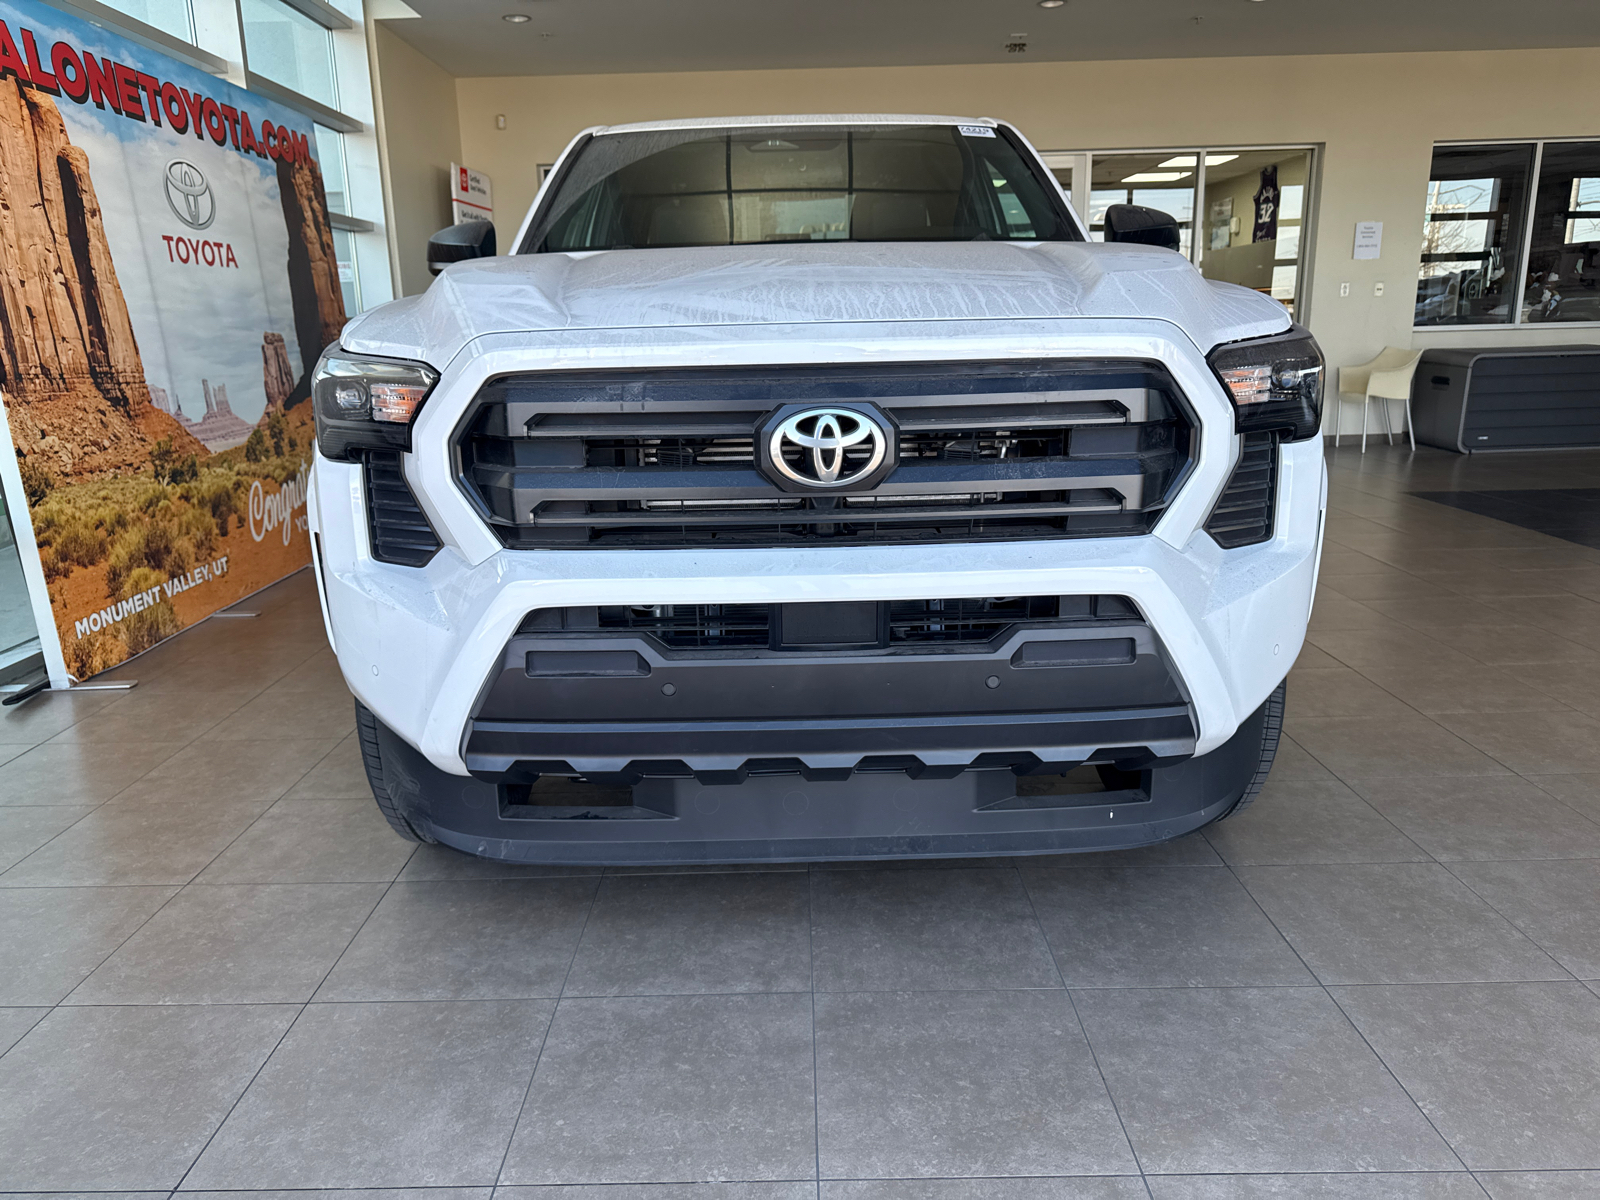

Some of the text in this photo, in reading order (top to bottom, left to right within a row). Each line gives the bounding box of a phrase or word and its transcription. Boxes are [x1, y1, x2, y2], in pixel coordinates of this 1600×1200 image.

[1258, 203, 1274, 223] 32
[161, 234, 239, 269] TOYOTA
[248, 458, 309, 547] Congrat
[74, 556, 229, 640] MONUMENT VALLEY, UT
